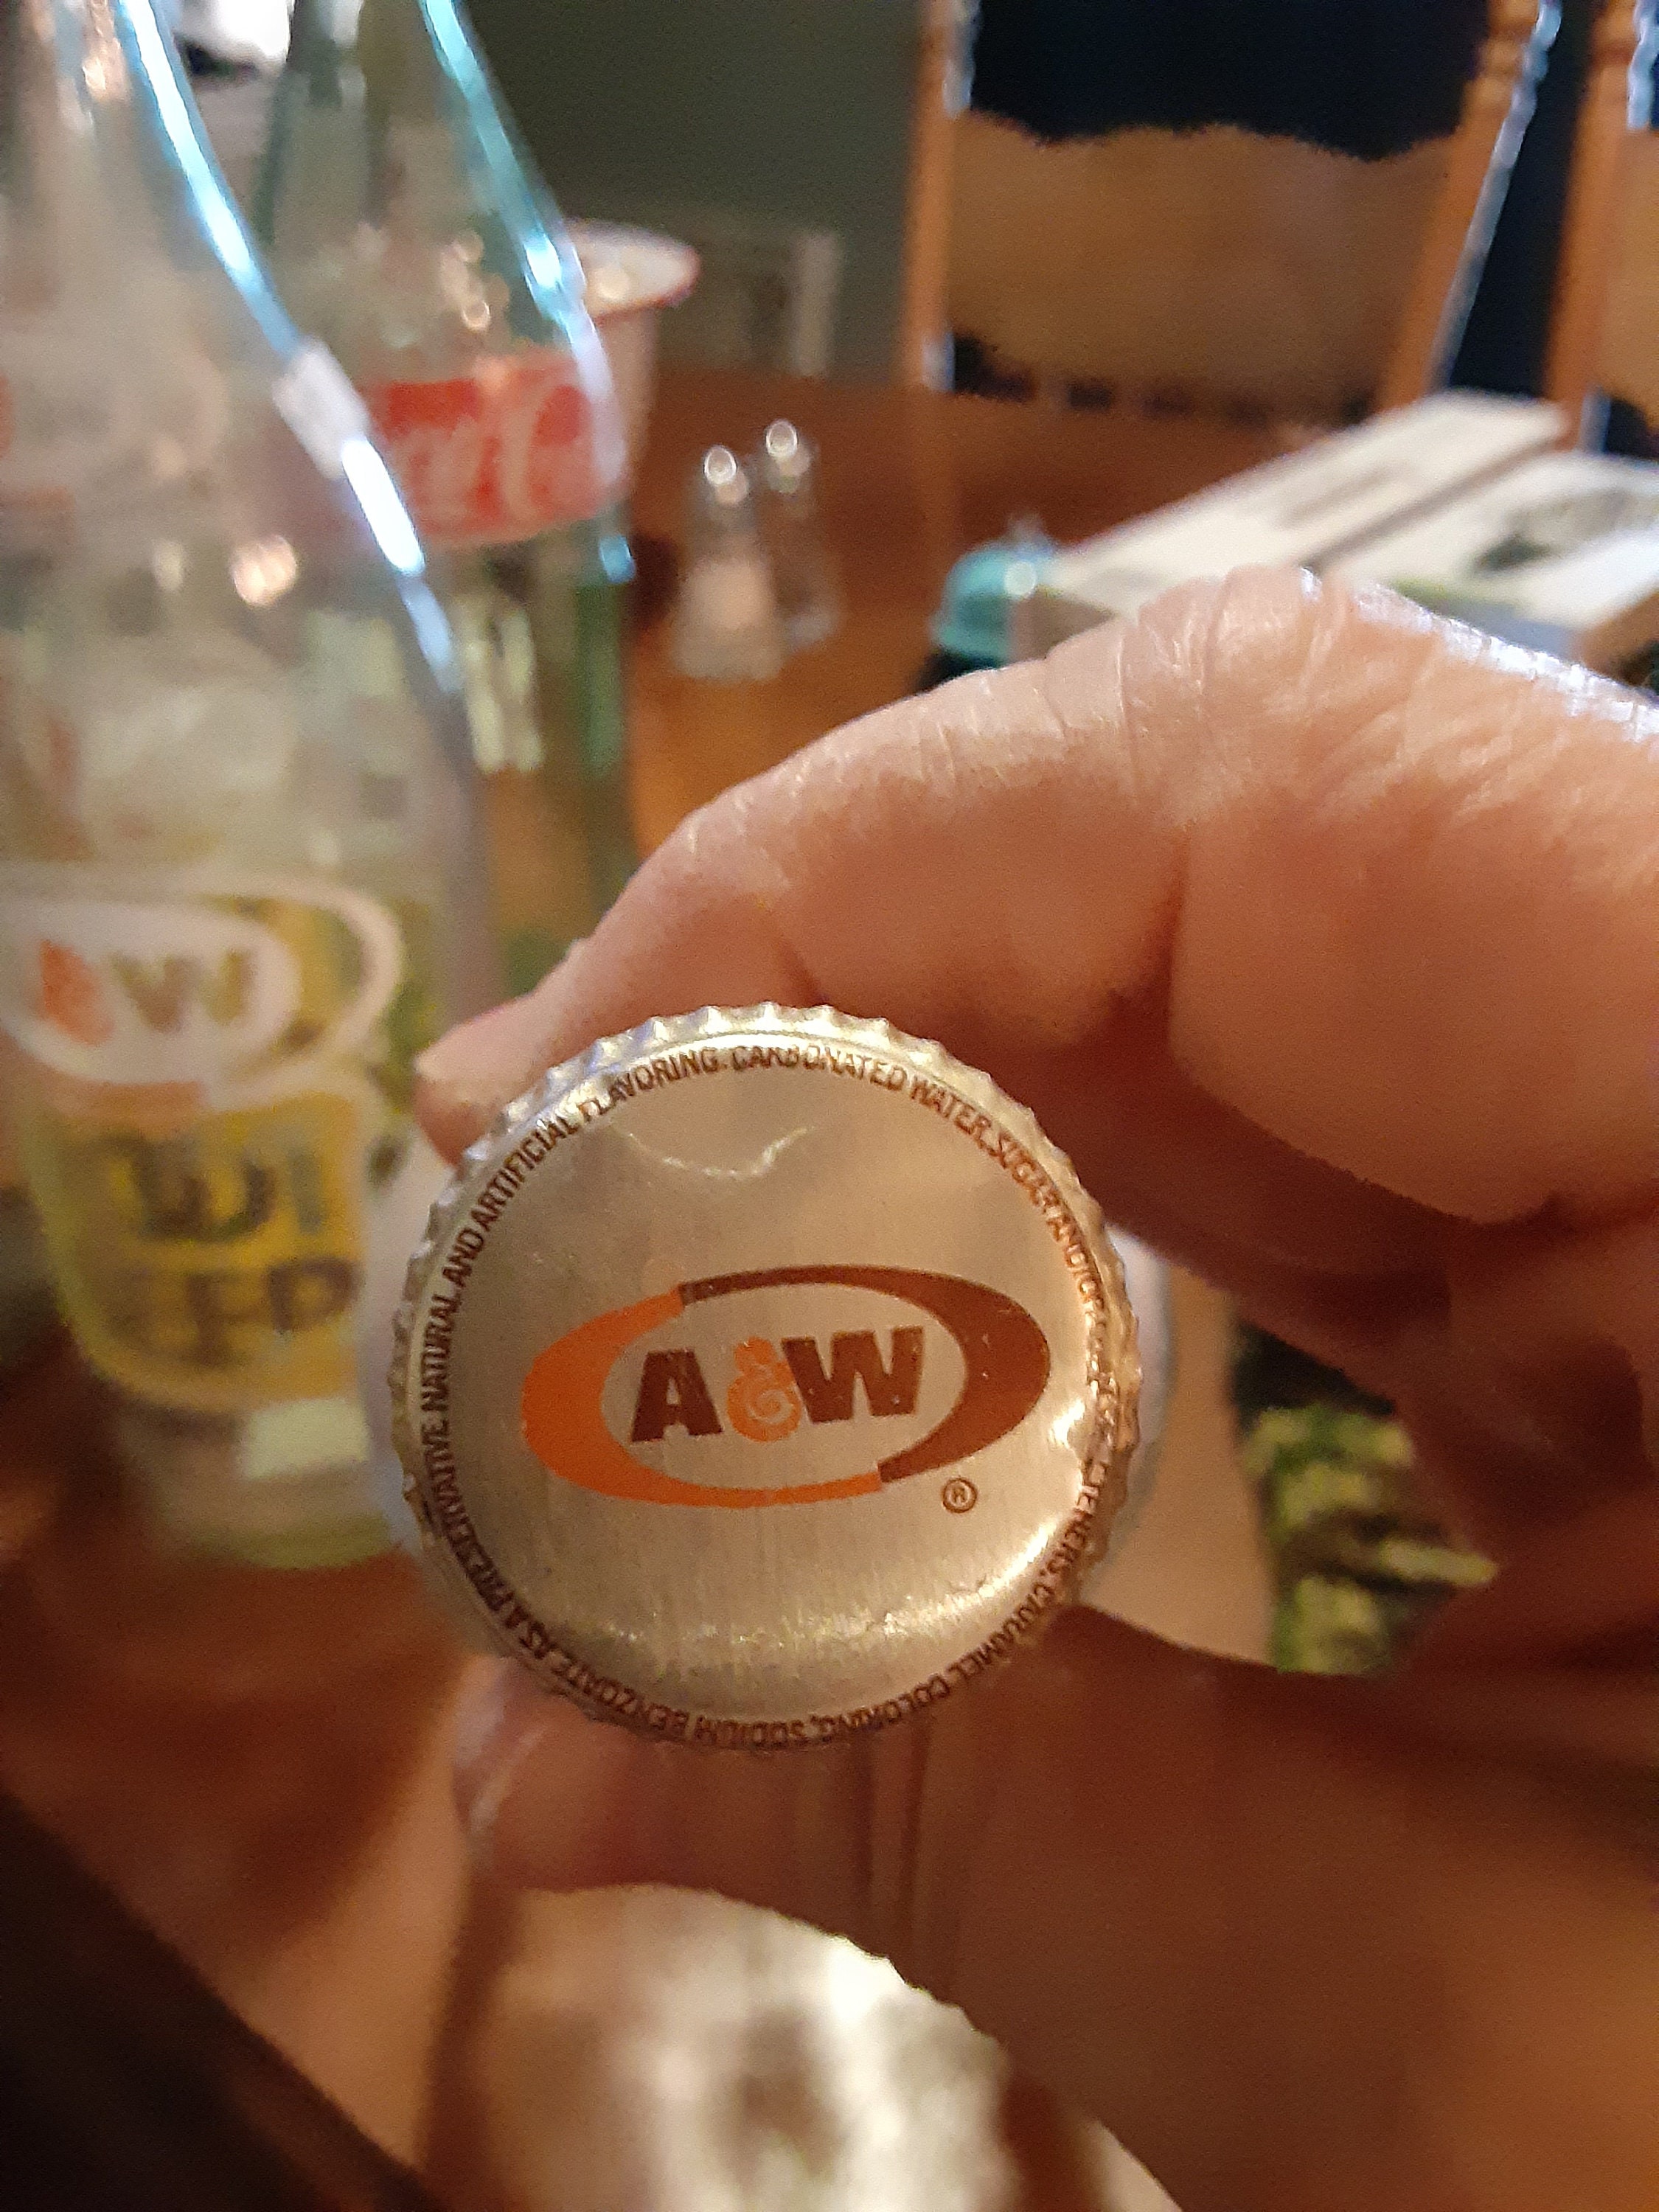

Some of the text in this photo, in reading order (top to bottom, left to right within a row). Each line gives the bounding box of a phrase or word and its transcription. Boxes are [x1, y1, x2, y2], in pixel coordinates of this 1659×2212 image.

[465, 1107, 583, 1233] ARTIFICIAL
[439, 1225, 487, 1289] AND
[420, 1286, 463, 1412] NATURAL
[630, 1326, 925, 1443] A&W
[499, 1603, 530, 1633] A
[517, 1620, 559, 1662] AS
